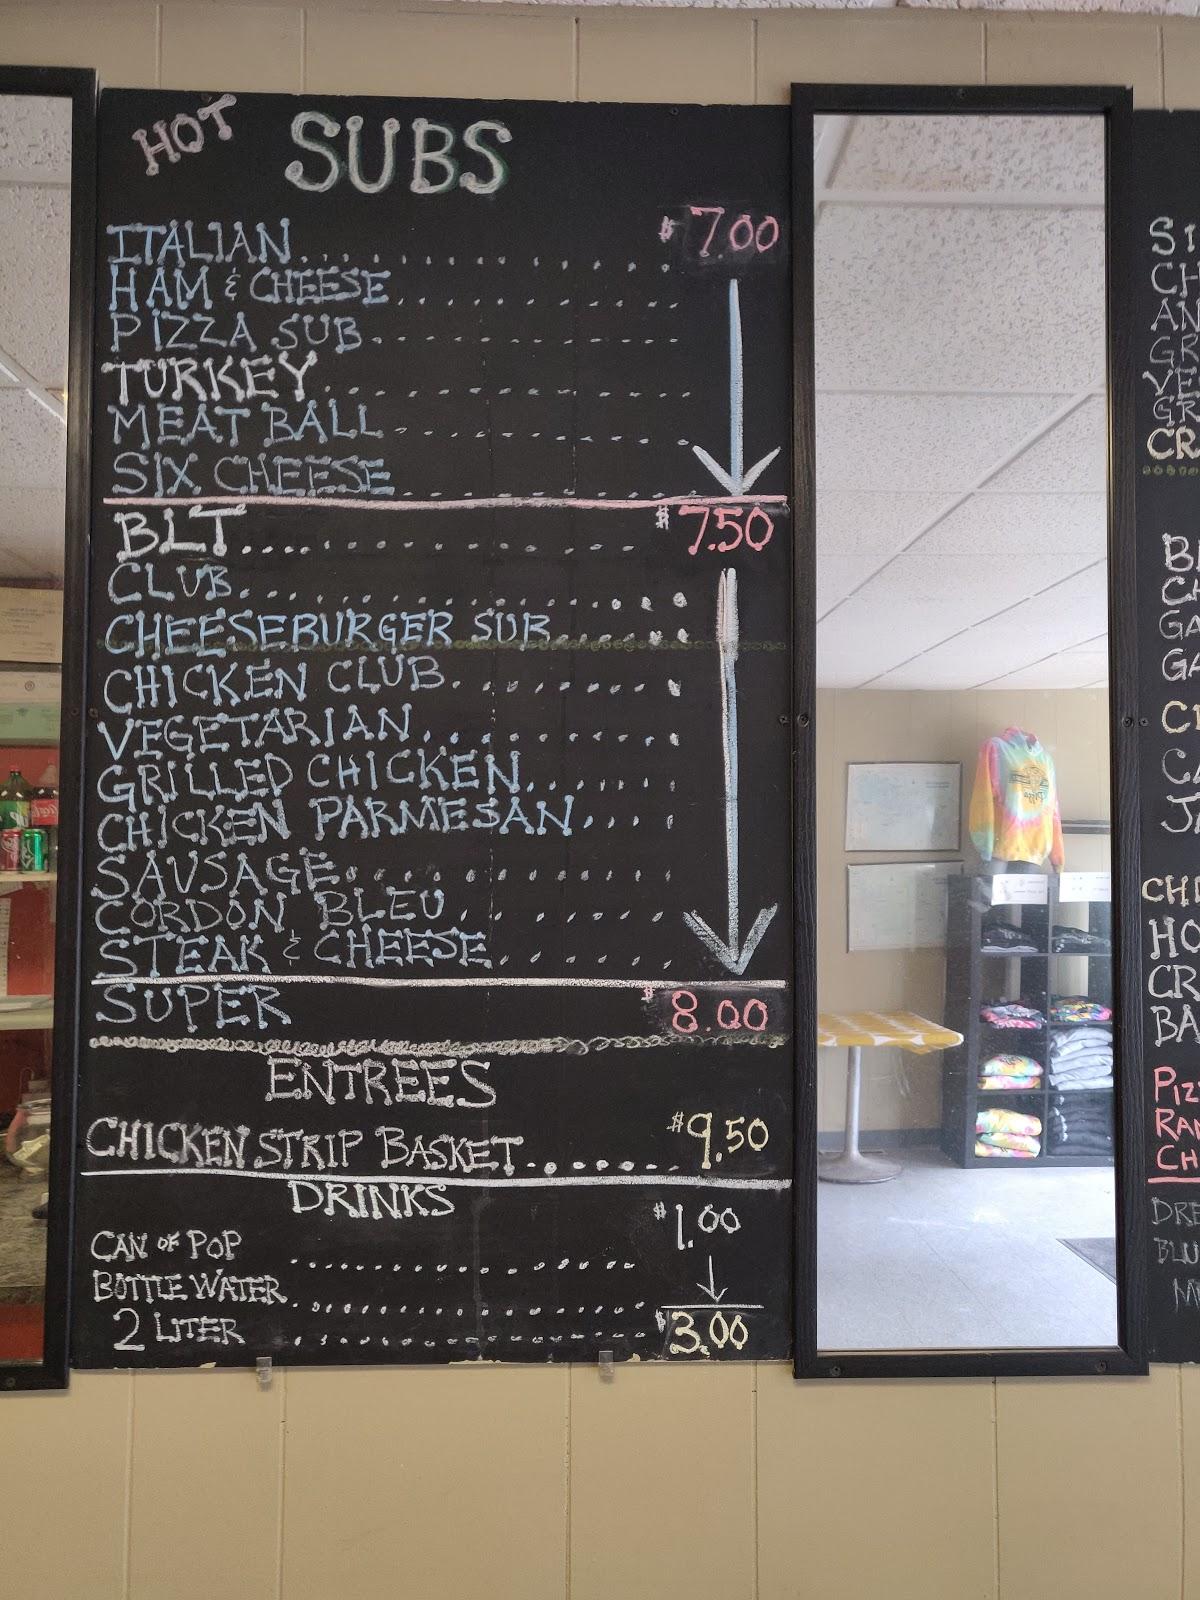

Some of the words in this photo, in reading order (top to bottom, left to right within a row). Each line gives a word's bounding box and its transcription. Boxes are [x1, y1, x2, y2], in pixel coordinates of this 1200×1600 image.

[131, 93, 237, 176] HOT
[284, 111, 513, 194] SUBS
[106, 217, 292, 268] ITALIAN
[109, 263, 213, 312] HAM
[249, 265, 391, 306] CHEESE
[111, 308, 257, 352] PIZZA
[271, 312, 362, 354] SUB
[101, 350, 318, 406] TURKEY
[1142, 367, 1200, 399] VE
[107, 402, 250, 450] MEAT
[261, 398, 385, 444] BALL
[112, 451, 201, 498] SIX
[213, 452, 396, 498] CHEESE
[113, 503, 248, 562] BLT
[1161, 533, 1200, 573] B
[107, 561, 233, 605] CLUB
[104, 605, 454, 660] CHEESEBURGER
[104, 658, 308, 714] CHICKEN
[328, 655, 446, 694] CLUB
[97, 703, 413, 760] VEGETARIAN
[97, 753, 294, 813] GRILLED
[307, 745, 521, 794] CHICKEN
[98, 799, 293, 854] CHICKEN
[309, 795, 576, 842] PARMESAN
[92, 850, 340, 902] SAUSAGE
[95, 892, 287, 935] CORDON
[315, 887, 446, 930] BLEU
[96, 931, 272, 980] STEAK
[314, 923, 494, 969] CHEESE
[96, 982, 293, 1032] SUPER
[265, 1055, 498, 1110] ENTREES
[1154, 1066, 1200, 1106] PIZ
[86, 1117, 250, 1169] CHICKEN
[254, 1126, 364, 1170] STRIP
[375, 1126, 524, 1176] BASKET
[288, 1180, 455, 1220] DRINKS
[90, 1230, 150, 1263] CAN
[93, 1268, 189, 1303] BOTTLE
[192, 1268, 288, 1305] WATER
[112, 1307, 145, 1352] 2
[153, 1312, 246, 1344] LITER
